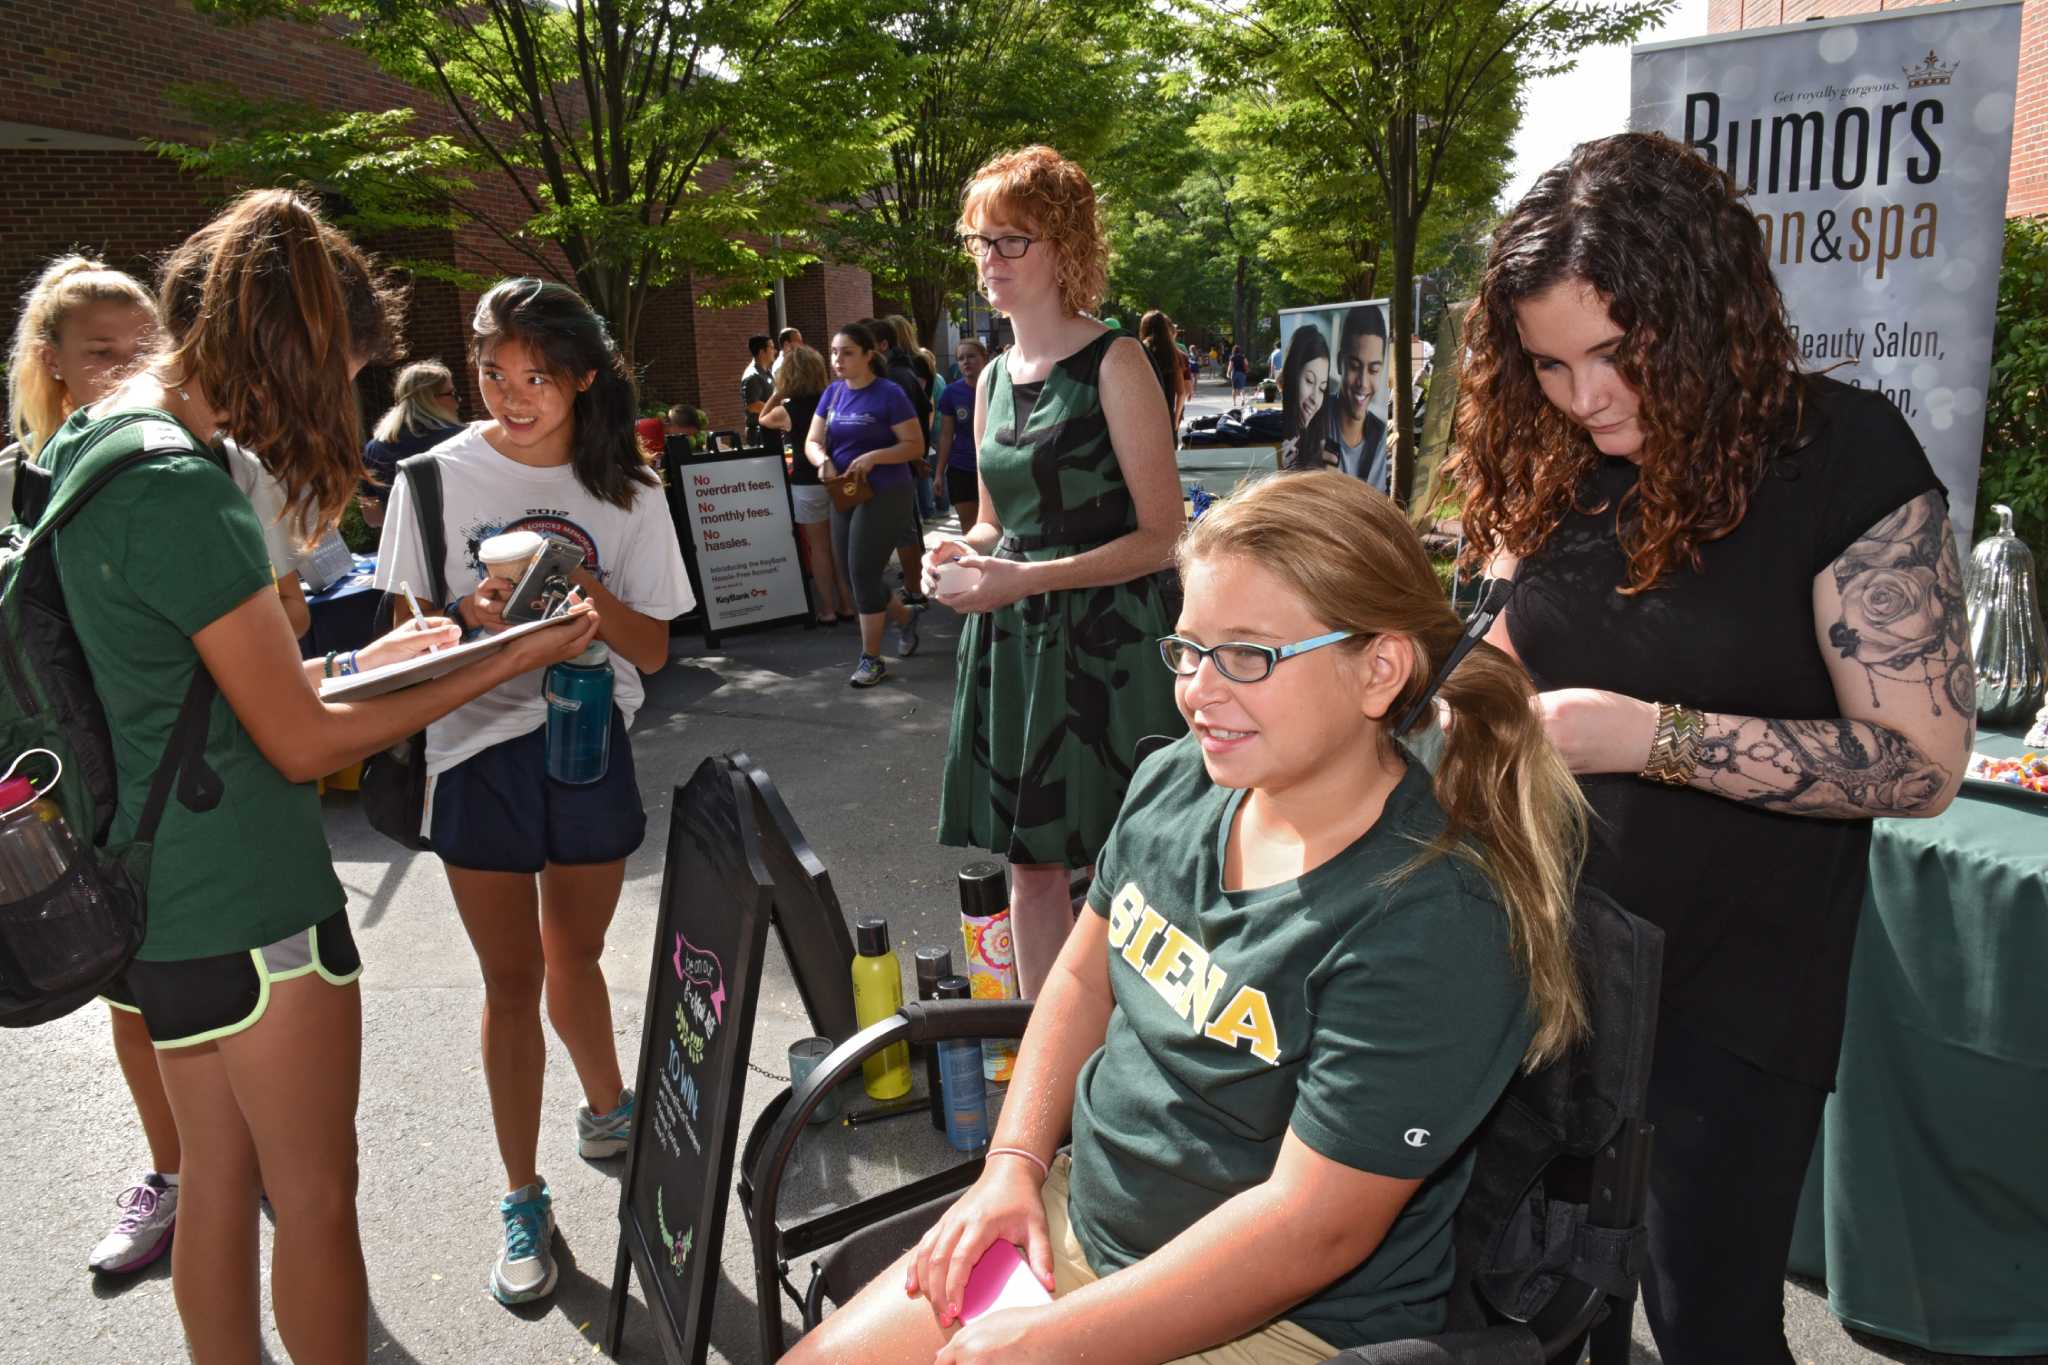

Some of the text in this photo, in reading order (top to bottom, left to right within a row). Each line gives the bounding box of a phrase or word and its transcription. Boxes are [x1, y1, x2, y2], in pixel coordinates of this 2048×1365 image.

[1774, 90, 1794, 104] Get
[1797, 85, 1838, 102] royally
[1685, 92, 1944, 196] Rumors
[1872, 321, 1945, 361] Salon,
[693, 474, 710, 486] No
[696, 480, 775, 498] overdraft fees.
[525, 508, 569, 517] 2012
[698, 502, 715, 513] No
[701, 507, 774, 525] monthly fees.
[703, 529, 720, 541] No
[704, 537, 752, 552] hassles.
[1107, 881, 1282, 1066] SIENA
